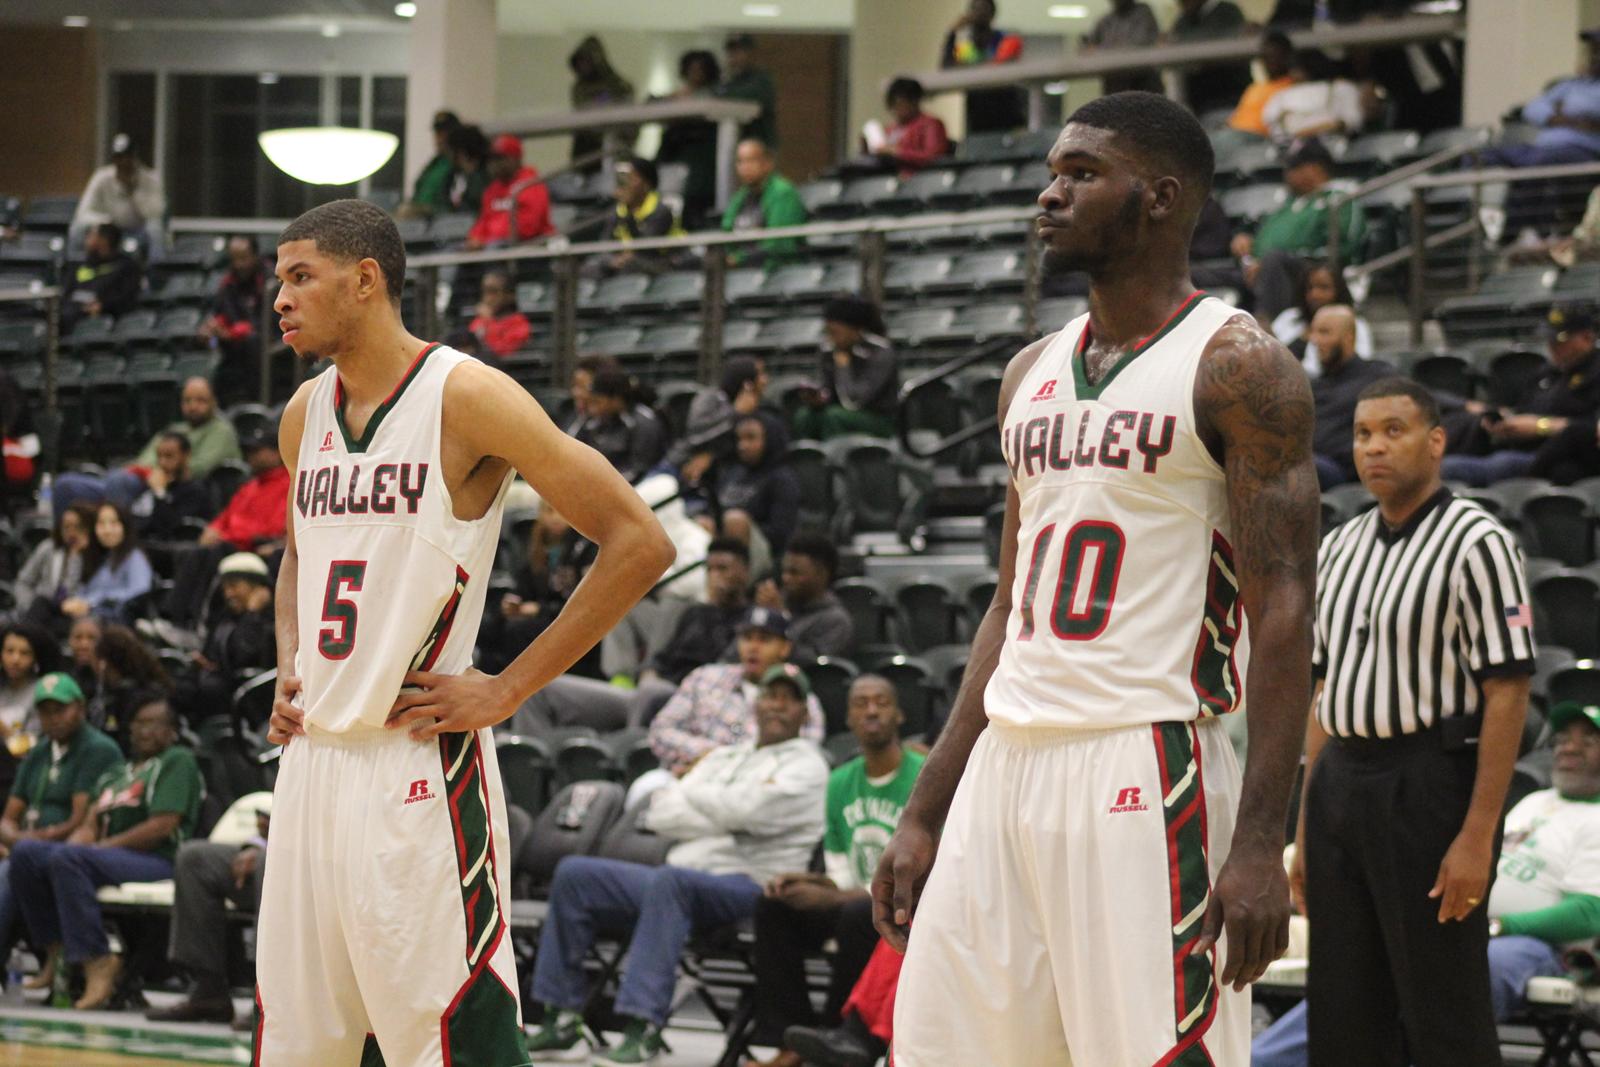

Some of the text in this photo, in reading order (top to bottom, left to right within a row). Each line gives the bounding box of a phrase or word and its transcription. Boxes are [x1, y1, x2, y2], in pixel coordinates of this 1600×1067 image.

[1004, 409, 1177, 482] VALLEY
[296, 463, 429, 519] VALLEY
[318, 560, 368, 661] 5
[1016, 519, 1126, 641] 10
